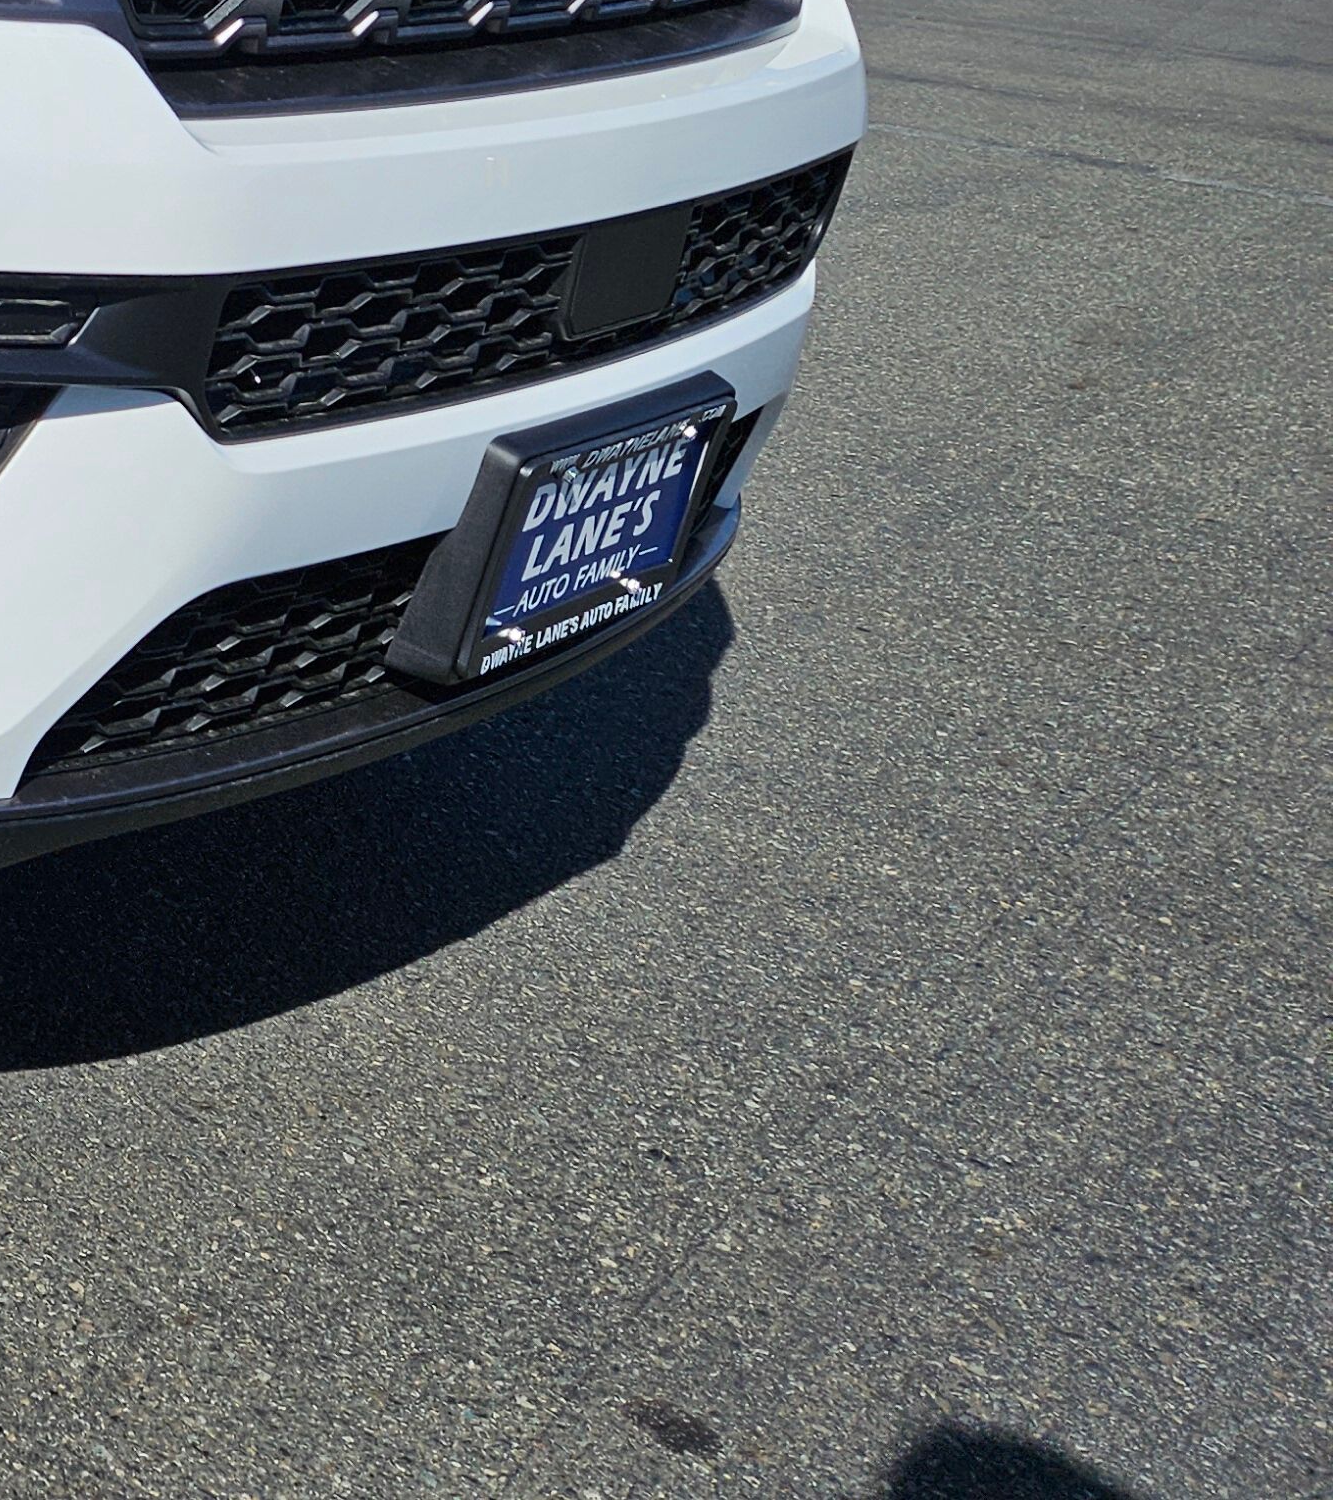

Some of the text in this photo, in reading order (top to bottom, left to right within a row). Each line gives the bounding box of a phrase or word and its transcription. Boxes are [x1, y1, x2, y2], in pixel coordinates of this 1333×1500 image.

[522, 439, 688, 532] DWAYNE
[513, 544, 641, 618] AUTO FAMILY
[521, 490, 662, 582] LANE'S
[480, 582, 664, 675] DWAYNE LANE'S AUTO FAMILY
